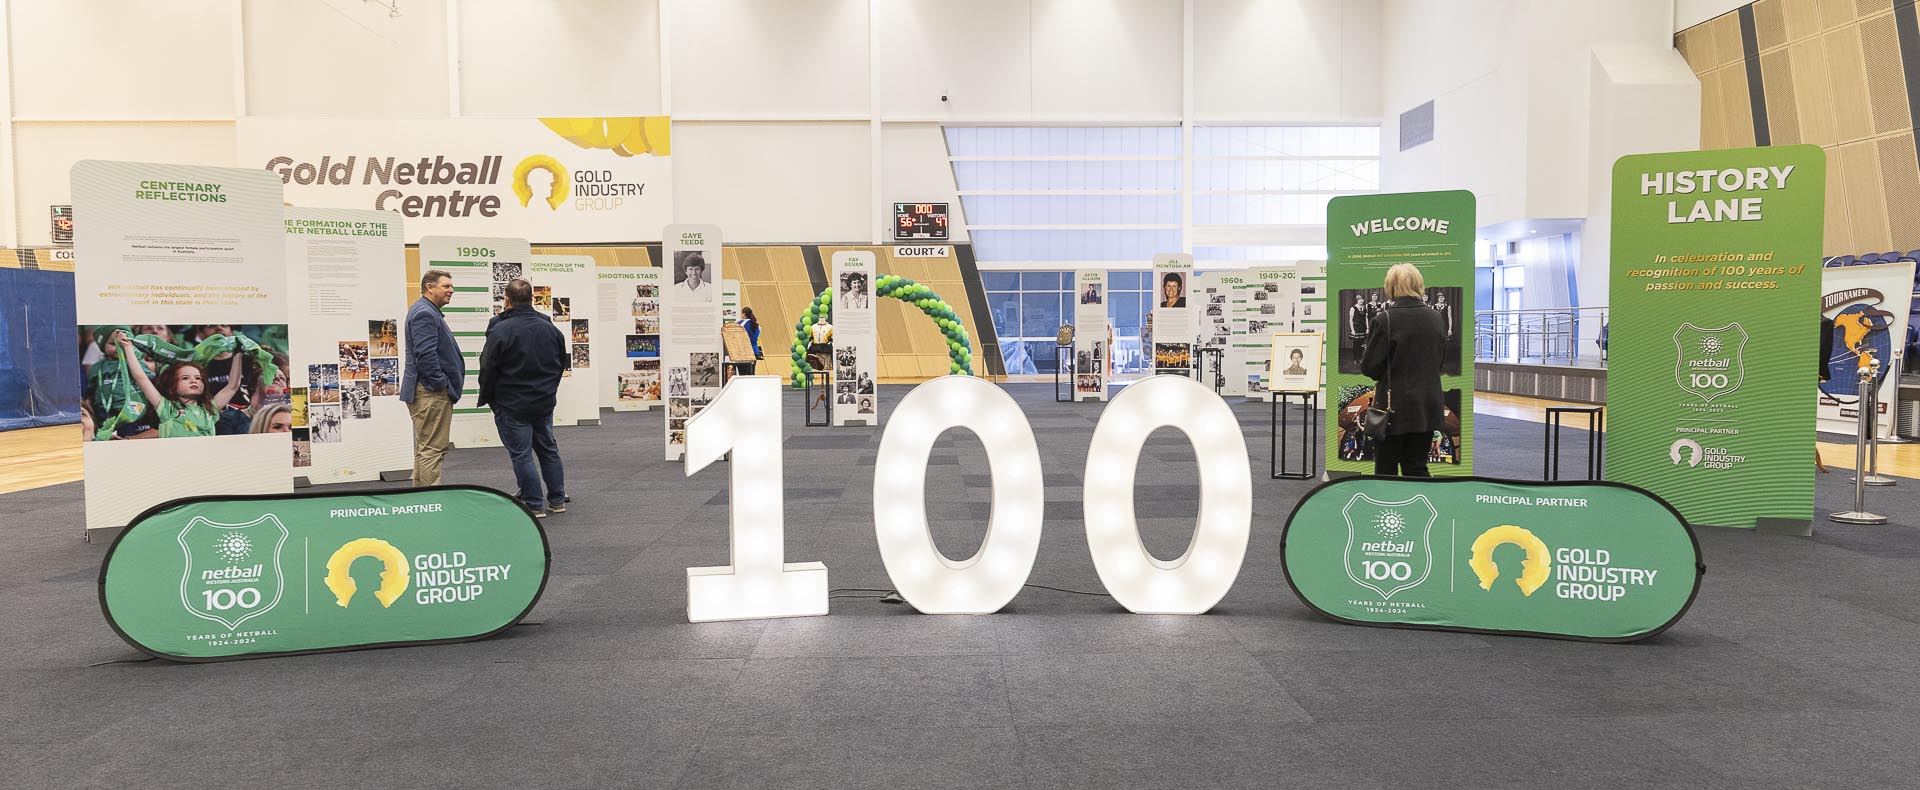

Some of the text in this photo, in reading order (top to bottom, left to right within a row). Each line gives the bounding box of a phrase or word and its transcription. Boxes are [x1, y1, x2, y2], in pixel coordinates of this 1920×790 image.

[265, 155, 503, 186] Gold Netball
[574, 170, 612, 184] GOLD
[140, 180, 222, 193] CENTENARY
[1640, 165, 1795, 196] HISTORY
[135, 190, 227, 203] REFLECTIONS
[574, 183, 646, 197] INDUSTRY
[374, 190, 501, 218] Centre
[574, 198, 624, 211] GROUP
[1667, 197, 1763, 224] LANE
[296, 219, 352, 229] FORMATION
[369, 222, 388, 230] THE
[900, 217, 947, 227] 56 47
[1350, 216, 1450, 237] WELCOME
[307, 227, 349, 236] NETBALL
[351, 229, 388, 237] LEAGUE
[456, 247, 496, 258] 1990s
[898, 247, 945, 256] COURT 4
[1655, 251, 1774, 264] In celebration and
[1627, 264, 1805, 279] recognition of 100 years of
[1645, 280, 1780, 292] passion and success.
[1824, 288, 1869, 308] TOURNAMENT
[1688, 358, 1730, 368] netball
[1688, 373, 1729, 389] 100
[1704, 447, 1727, 455] GOLD
[1704, 454, 1746, 463] INDUSTRY
[1704, 461, 1733, 470] GROUP
[1475, 493, 1588, 508] PRINCIPAL PARTNER
[329, 503, 443, 519] PRINCIPAL PARTNER
[1361, 540, 1414, 553] netball
[414, 551, 468, 571] GOLD
[1556, 547, 1610, 566] GOLD
[201, 564, 263, 580] netball
[414, 564, 512, 588] INDUSTRY
[1361, 560, 1412, 581] 100
[1556, 565, 1658, 587] INDUSTRY
[202, 587, 262, 611] 100
[414, 584, 484, 606] GROUP
[1556, 582, 1626, 602] GROUP
[186, 633, 217, 641] YEARS
[236, 629, 279, 638] NETBALL
[207, 638, 256, 647] 1924-2024
